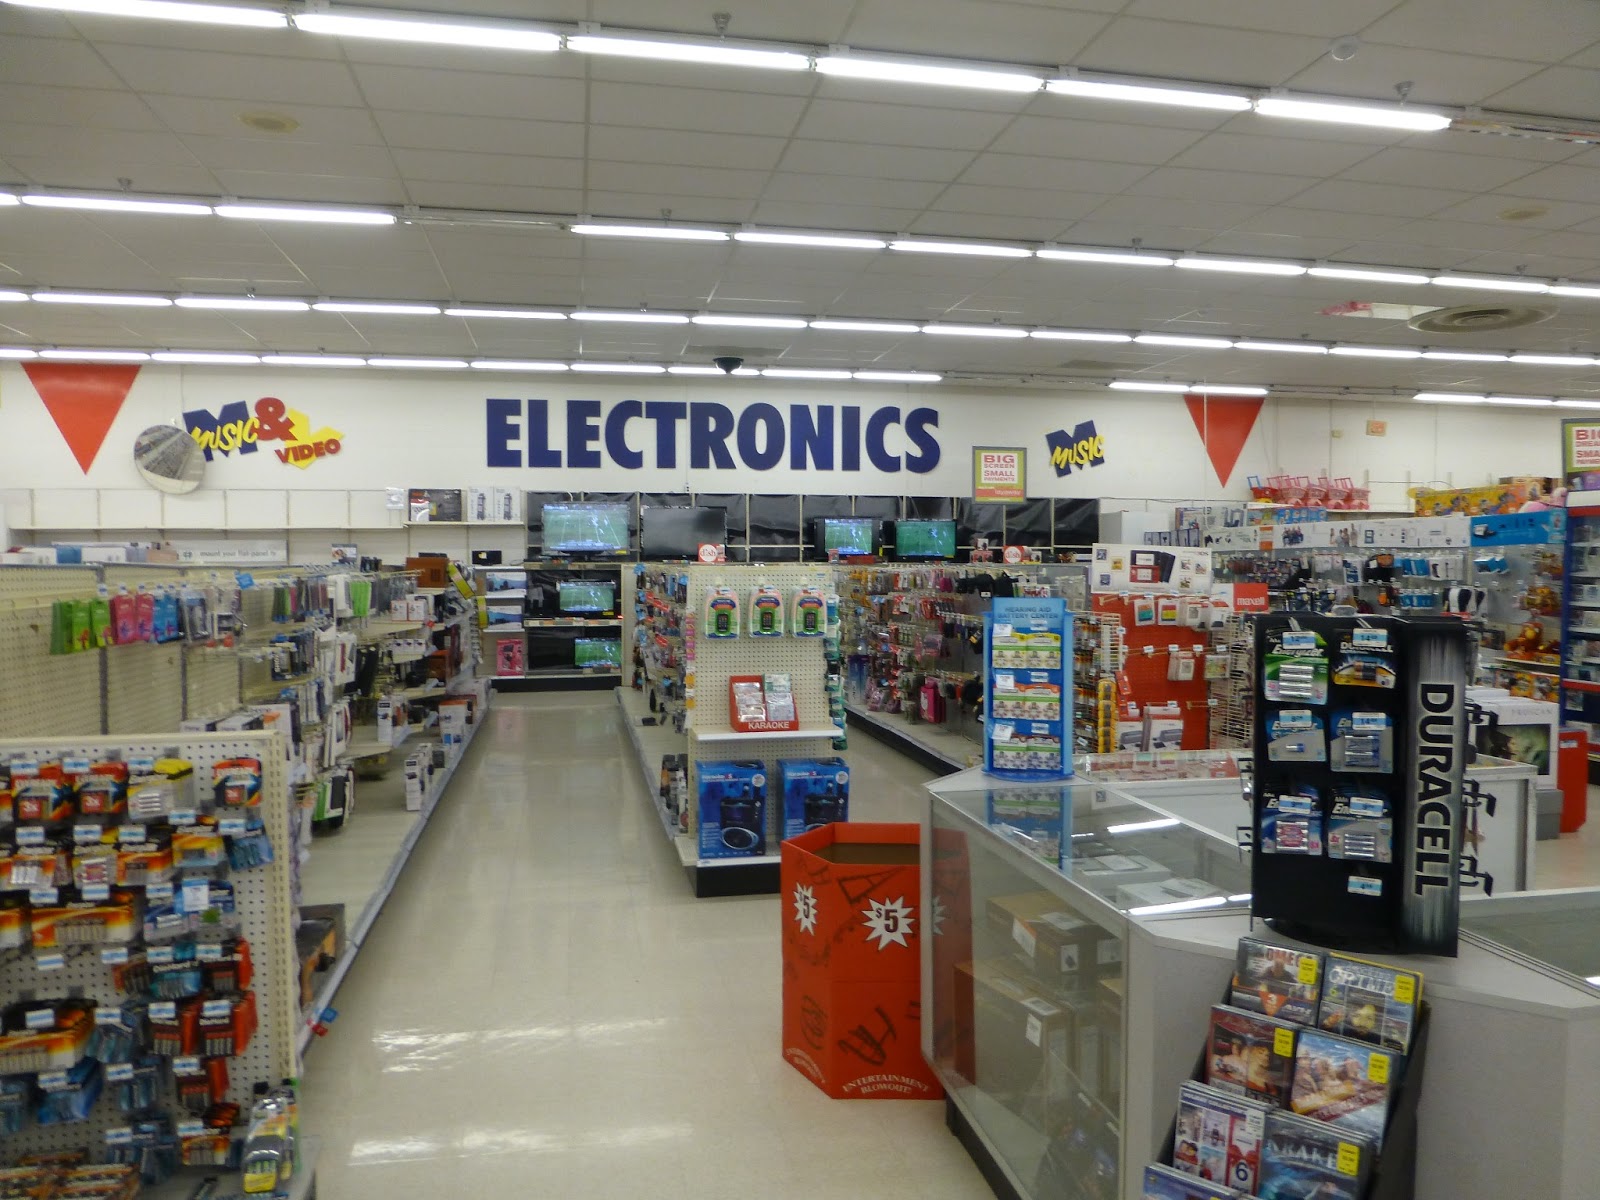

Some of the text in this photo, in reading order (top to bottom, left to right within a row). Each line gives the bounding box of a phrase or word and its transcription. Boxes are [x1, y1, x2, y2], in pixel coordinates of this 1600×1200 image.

[190, 417, 260, 451] MUSIC
[486, 398, 941, 474] ELECTRONICS
[274, 438, 341, 464] VIDEO
[983, 454, 1015, 464] BIG
[1050, 434, 1105, 470] MUSIC
[700, 547, 716, 557] dish
[1005, 550, 1019, 559] dish
[1236, 596, 1266, 606] maxell
[748, 721, 790, 730] KARAOKE
[1414, 683, 1455, 896] DURACELL
[875, 907, 899, 933] $5
[842, 1074, 929, 1093] ENTERTAINMENT
[1235, 1161, 1249, 1182] 6
